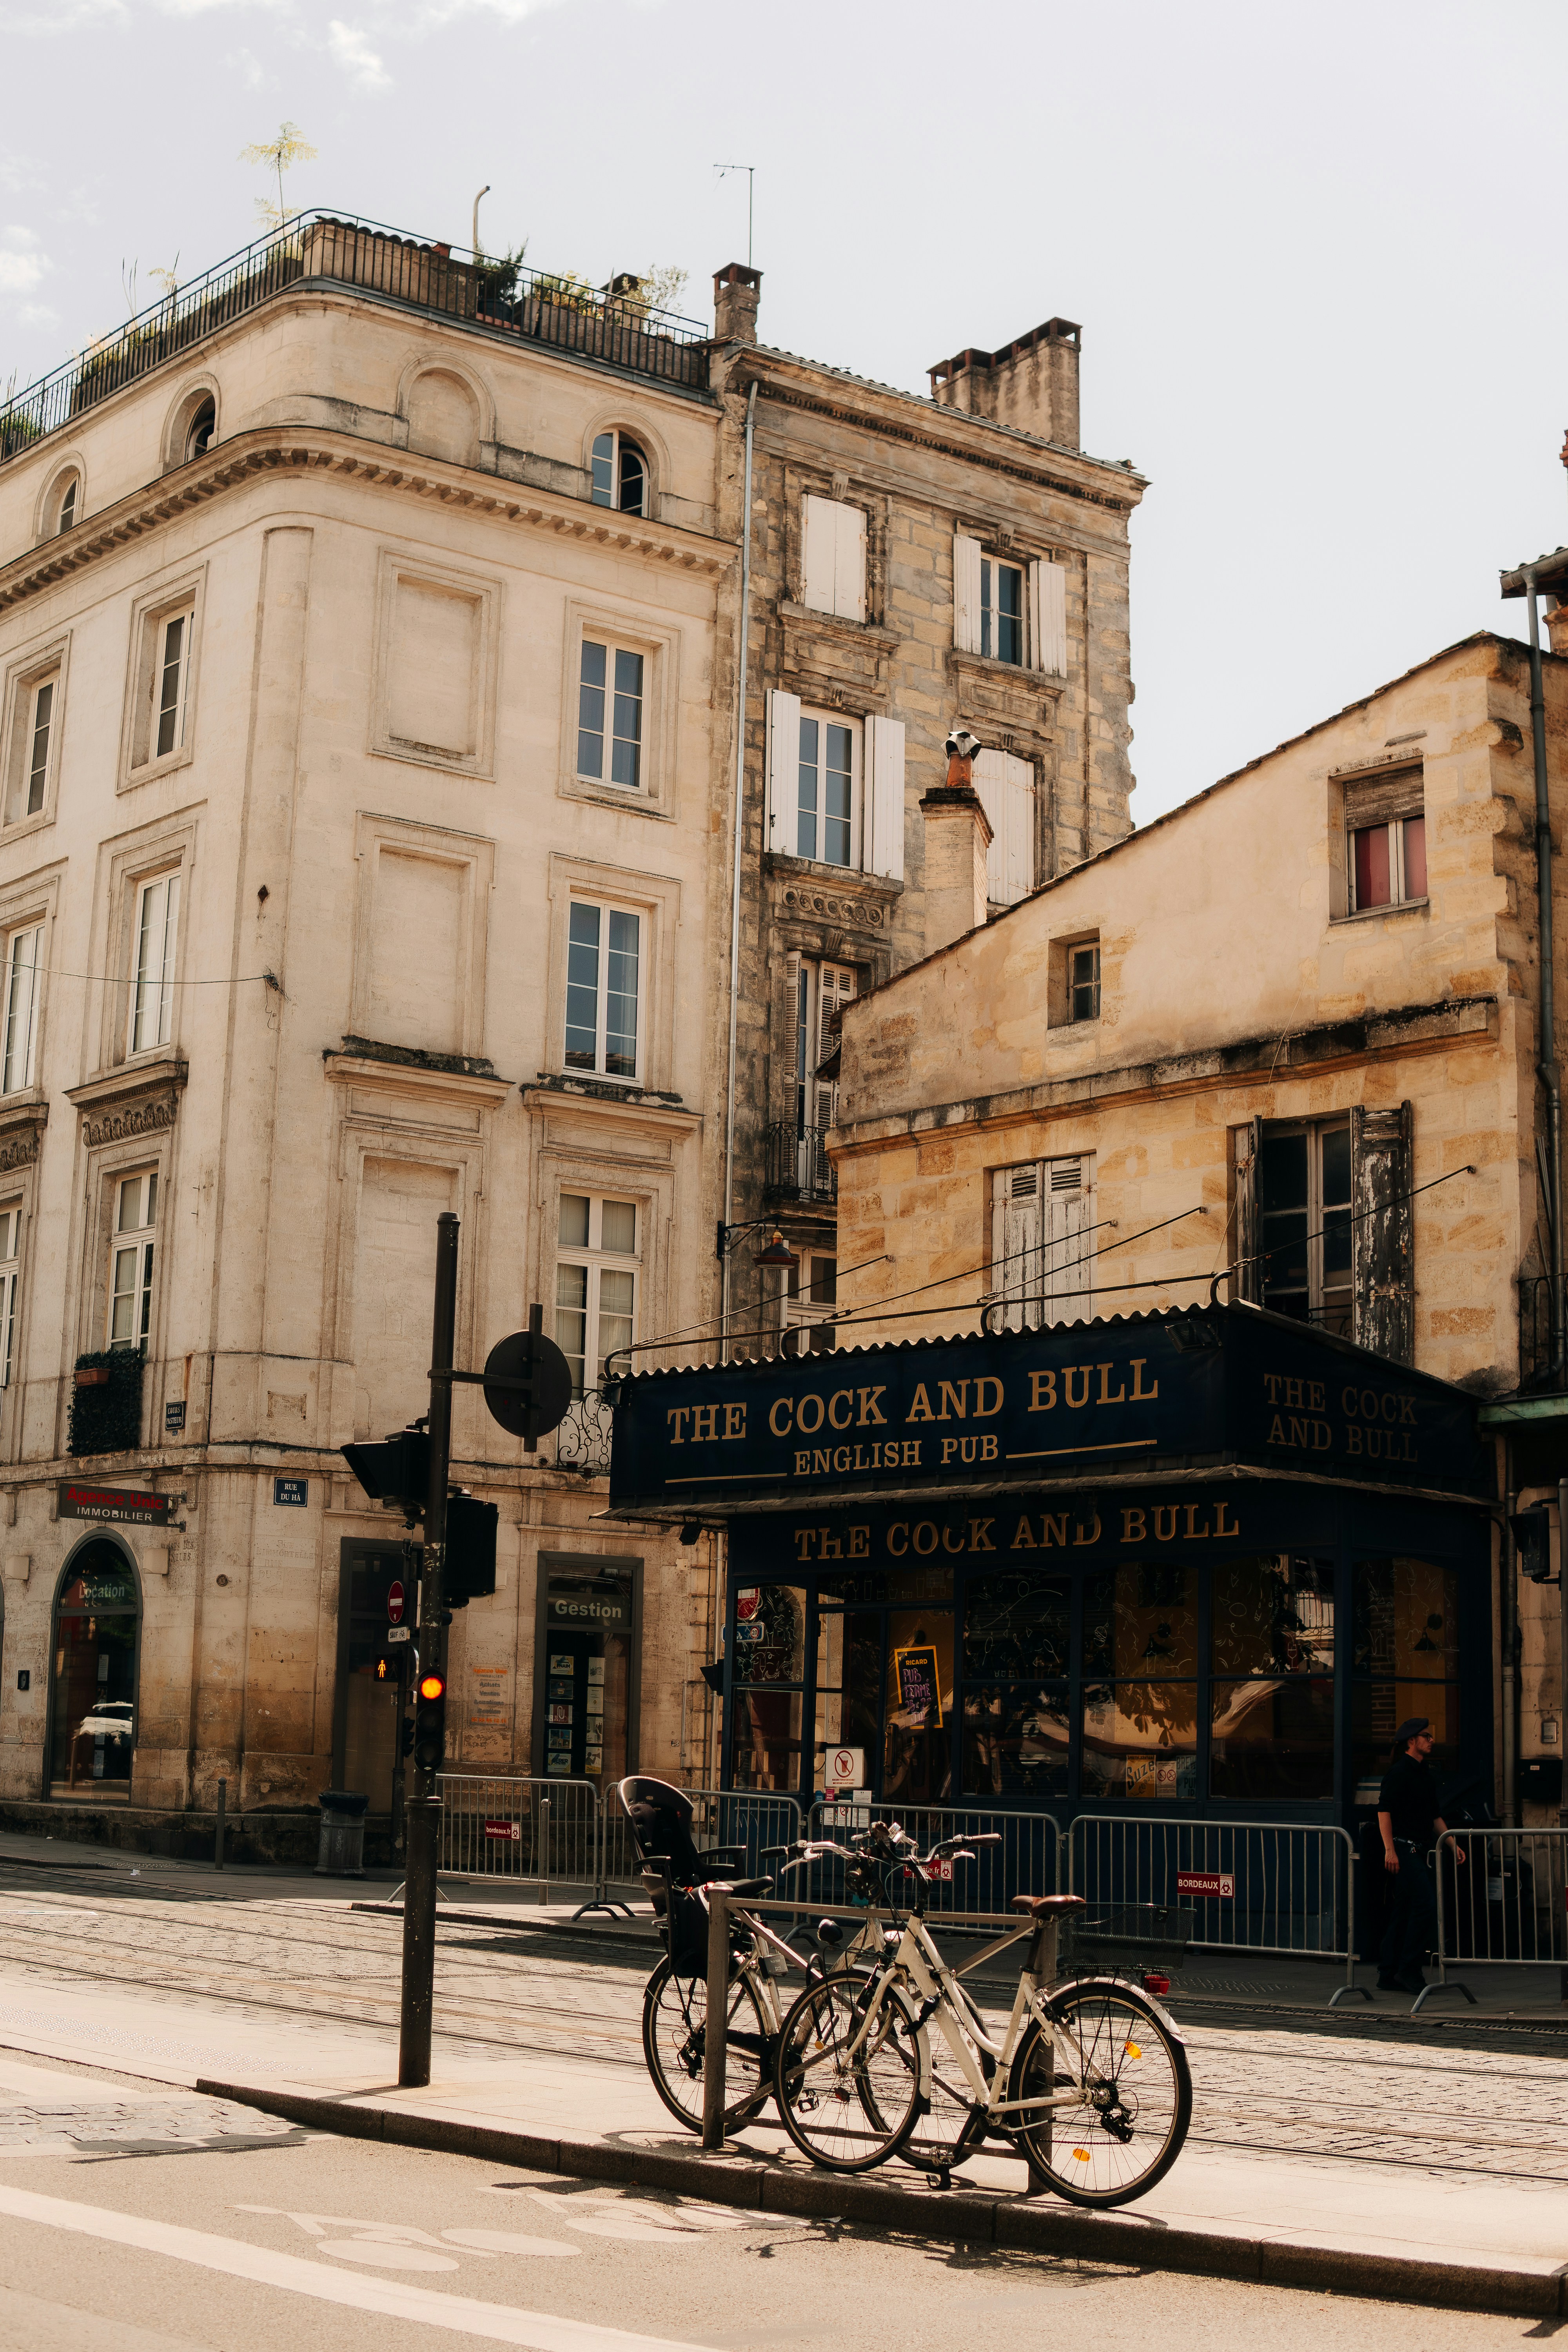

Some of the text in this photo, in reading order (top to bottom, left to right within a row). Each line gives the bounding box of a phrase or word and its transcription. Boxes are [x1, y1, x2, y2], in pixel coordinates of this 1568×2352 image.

[667, 1358, 1158, 1444] THE COCK AND BULL
[1264, 1373, 1419, 1425] THE COCK
[168, 1406, 181, 1414] COURS
[166, 1416, 182, 1425] PASTEUR
[1267, 1414, 1419, 1463] AND BULL
[794, 1435, 999, 1475] ENGLISH PUB
[67, 1486, 164, 1509] Agence Unic
[291, 1492, 301, 1501] HÂ
[77, 1507, 152, 1522] IMMOBILIER
[794, 1502, 1240, 1561] THE COCK AND BULL
[79, 1583, 125, 1599] Location
[555, 1600, 621, 1618] Gestion
[903, 1668, 922, 1683] PUB
[904, 1678, 931, 1699] FERMÉ
[486, 1826, 511, 1835] bordeaux.fr
[1178, 1879, 1219, 1890] BORDEAUX
